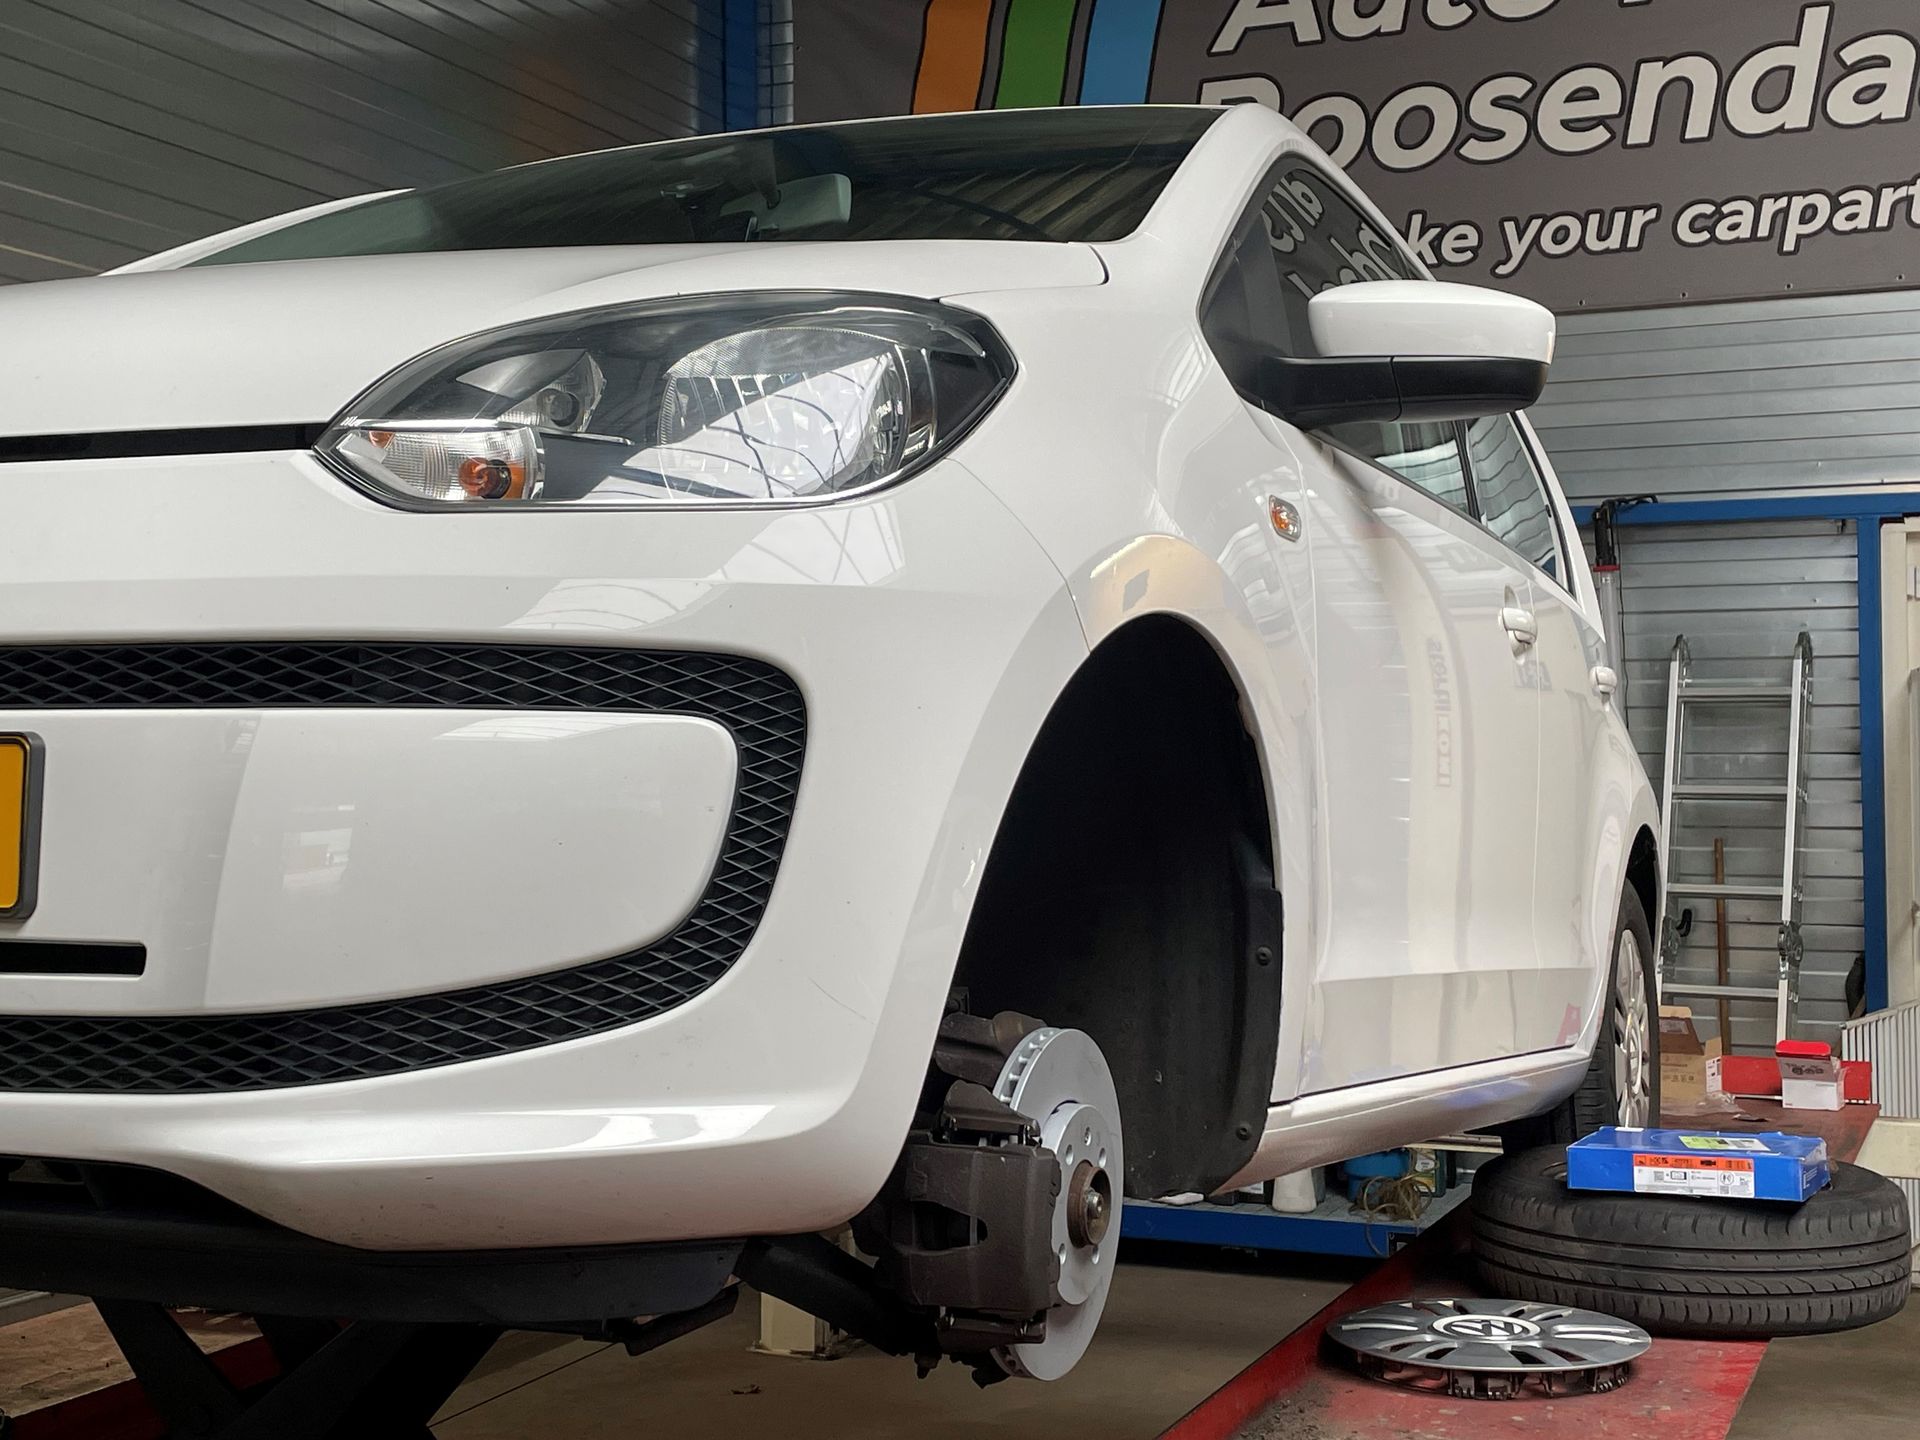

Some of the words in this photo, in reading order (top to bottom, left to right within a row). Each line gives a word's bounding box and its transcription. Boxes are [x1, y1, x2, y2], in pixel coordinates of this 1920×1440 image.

[1200, 5, 1917, 170] oosenda
[1406, 212, 1479, 265] ke
[1494, 206, 1658, 276] your
